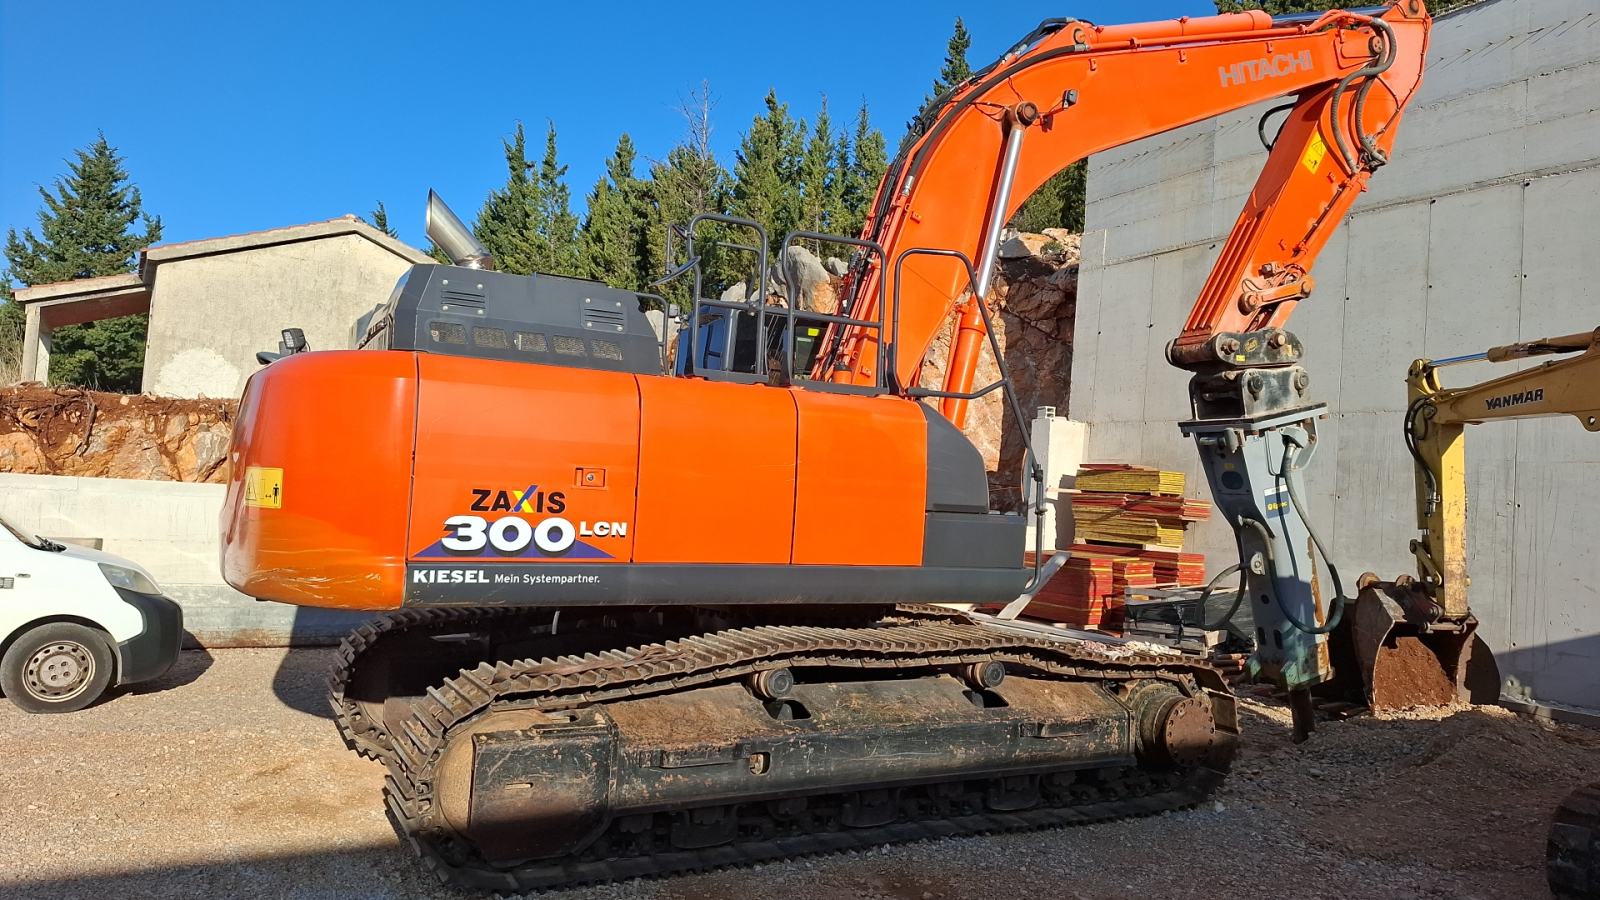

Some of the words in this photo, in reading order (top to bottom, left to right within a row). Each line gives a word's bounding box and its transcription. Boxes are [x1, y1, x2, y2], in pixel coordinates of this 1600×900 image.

[1218, 50, 1313, 87] HITACHI
[1486, 388, 1544, 410] YANMAR
[471, 485, 566, 513] ZAXIS
[441, 516, 576, 555] 300
[579, 521, 628, 537] LCN
[413, 569, 490, 584] KIESEL
[494, 573, 520, 584] Mein
[523, 573, 600, 586] Systempartner.
